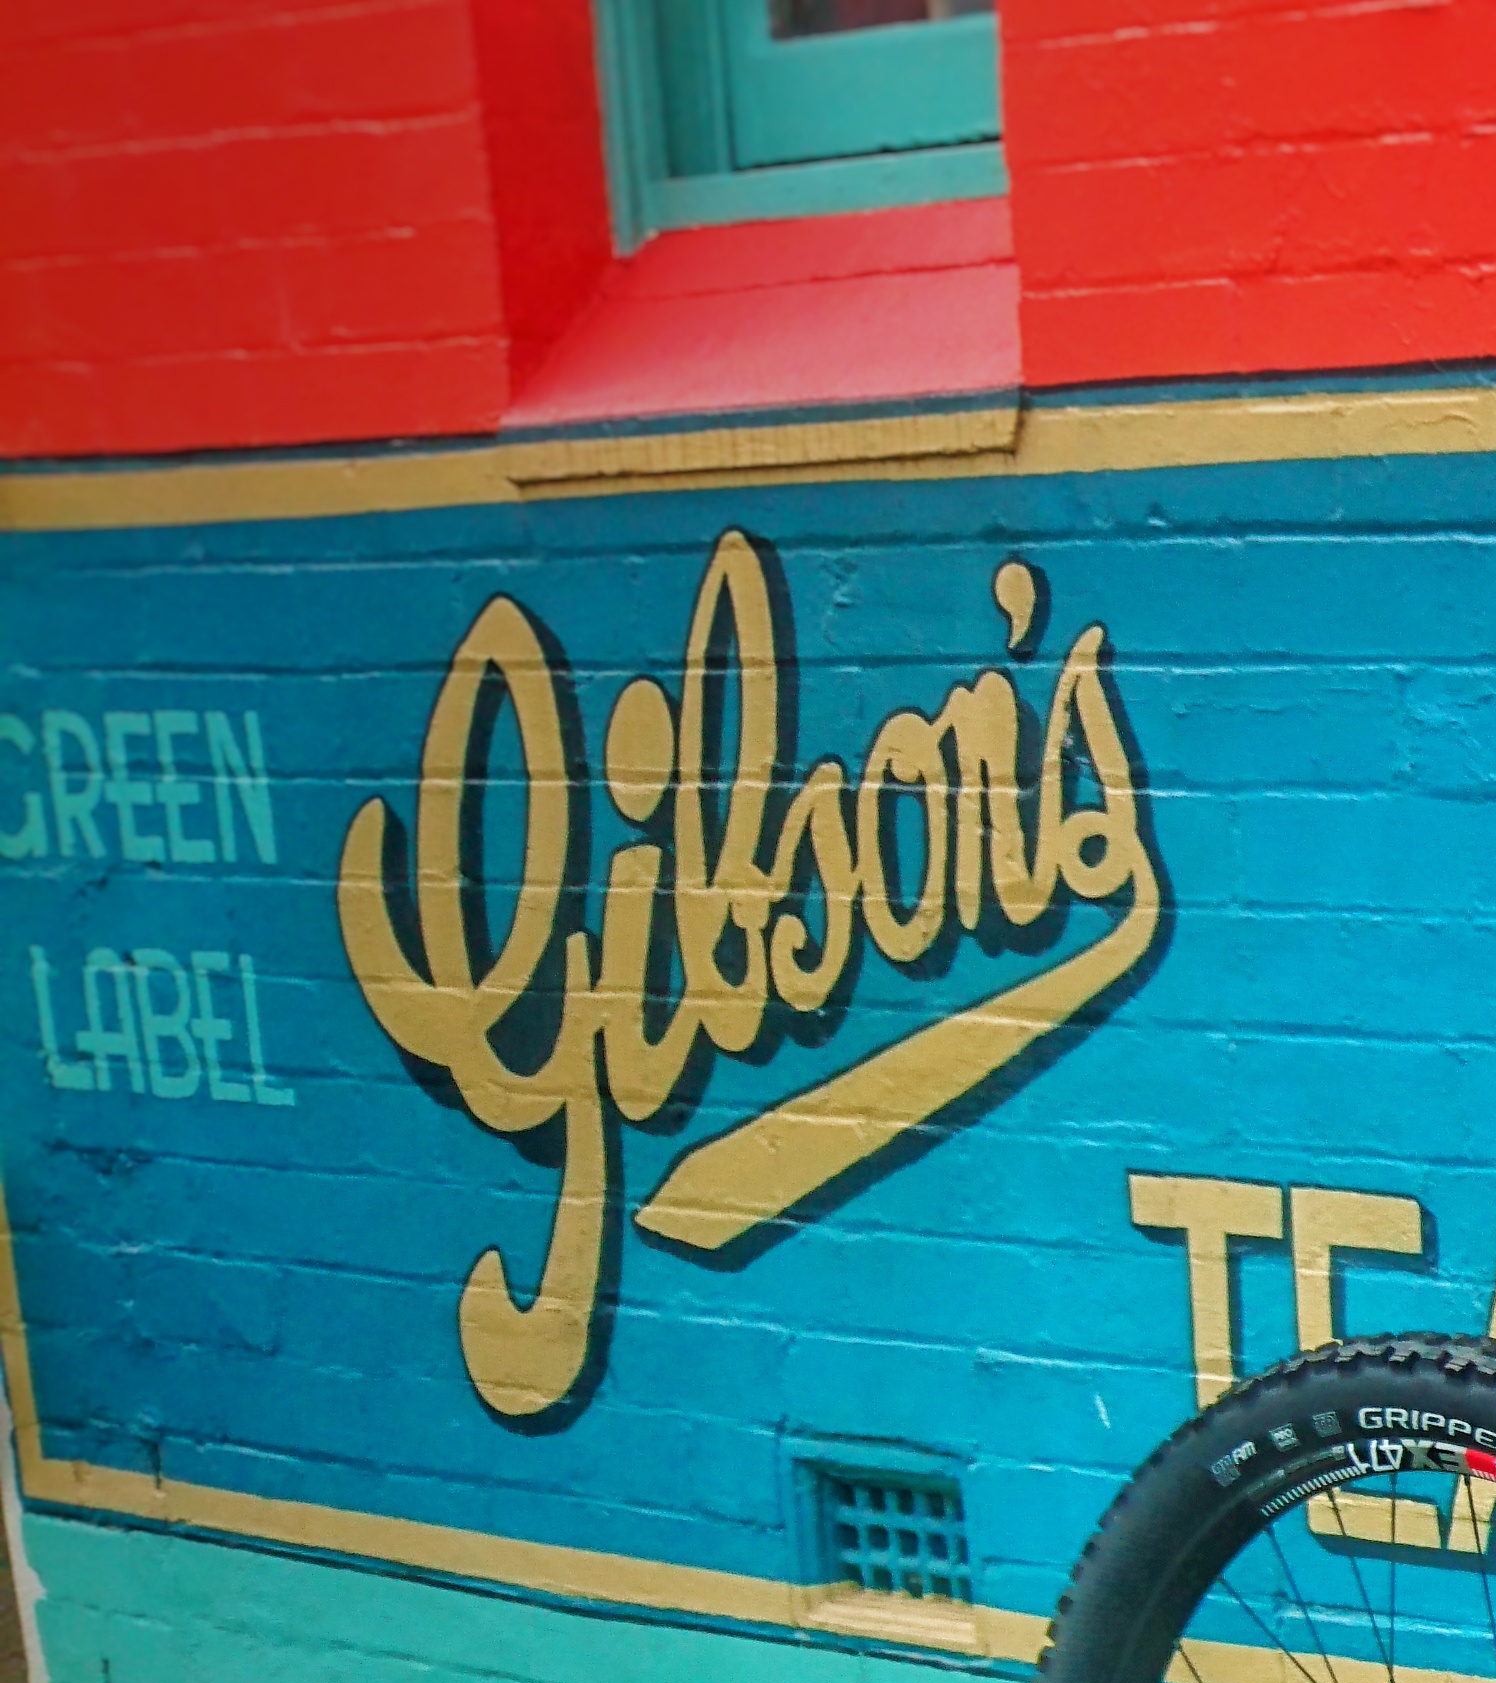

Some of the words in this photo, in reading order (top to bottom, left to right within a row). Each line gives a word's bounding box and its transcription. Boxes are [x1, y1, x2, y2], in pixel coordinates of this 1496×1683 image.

[0, 706, 278, 866] GREEN
[32, 943, 296, 1108] LABEL
[336, 526, 1165, 1432] Gibson's
